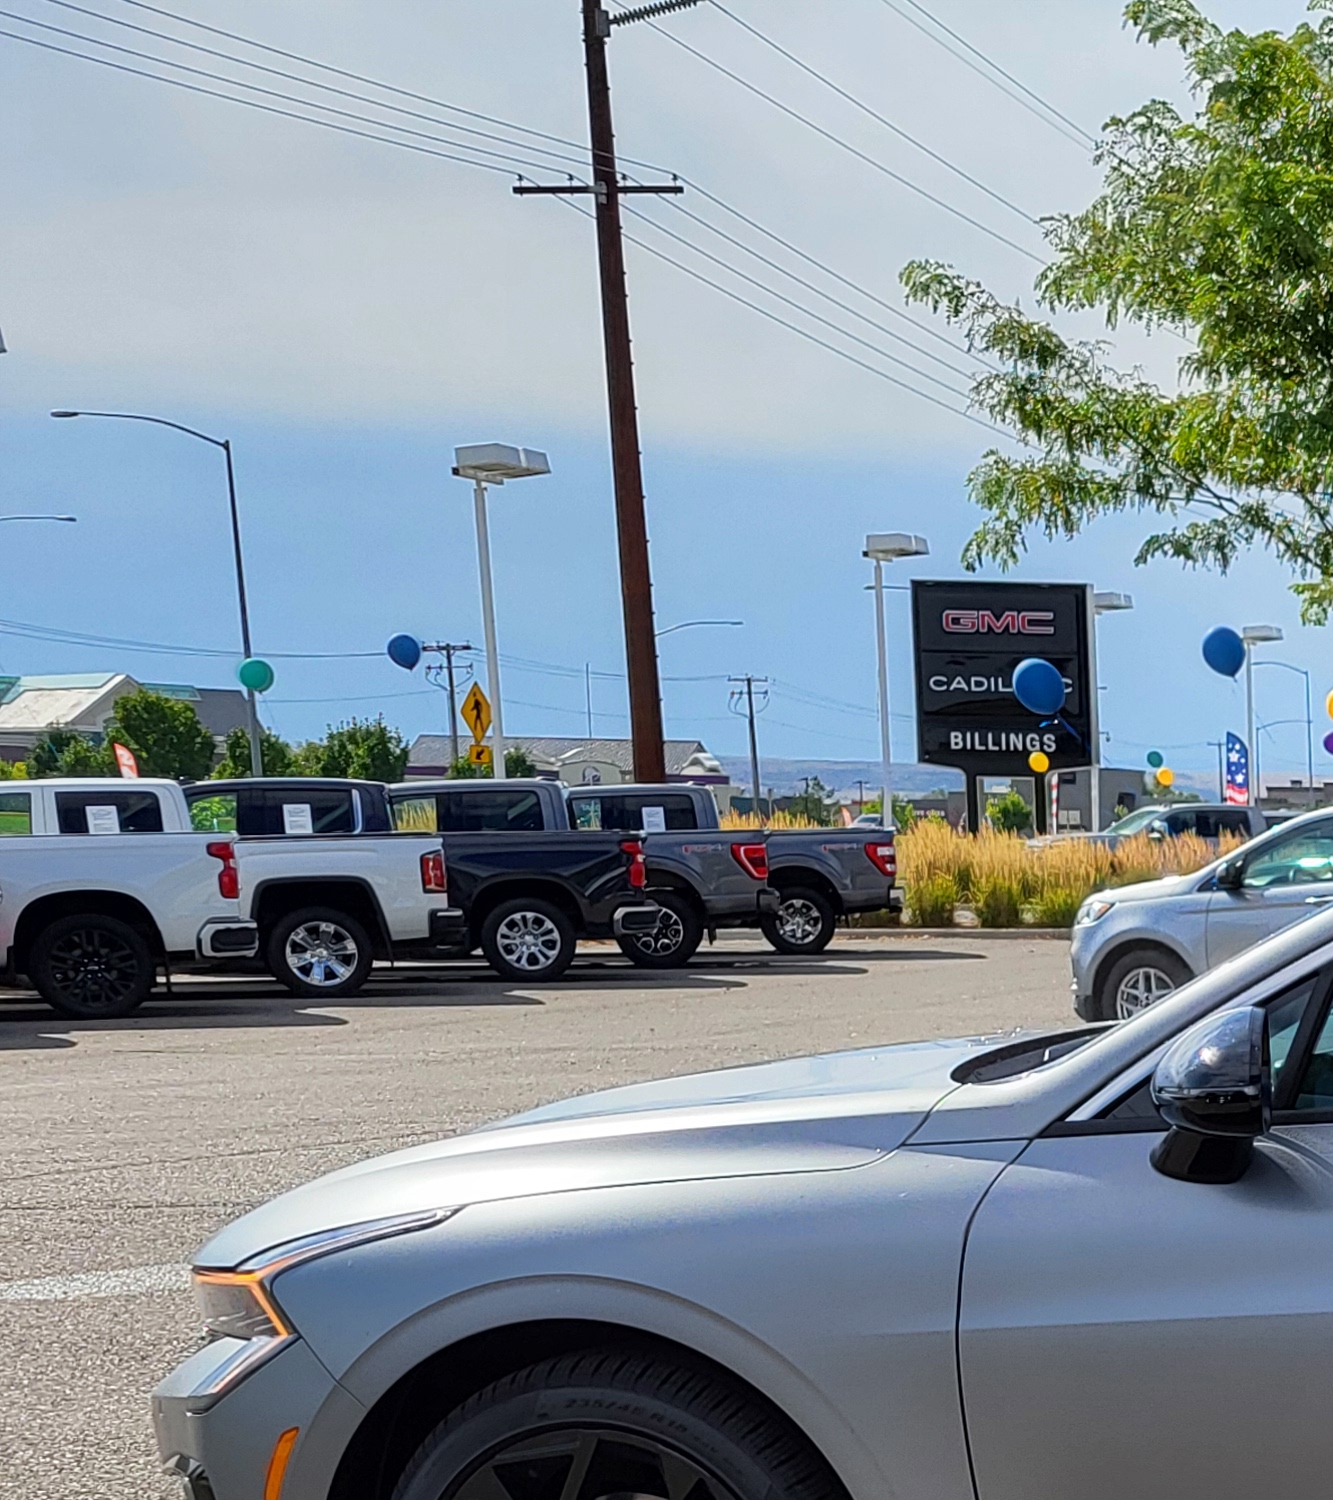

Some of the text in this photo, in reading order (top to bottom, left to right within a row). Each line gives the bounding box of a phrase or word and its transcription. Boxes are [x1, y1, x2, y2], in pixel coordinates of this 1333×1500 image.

[942, 609, 1055, 635] GMC
[929, 675, 1073, 693] CADILC
[950, 731, 1057, 752] BILLINGS
